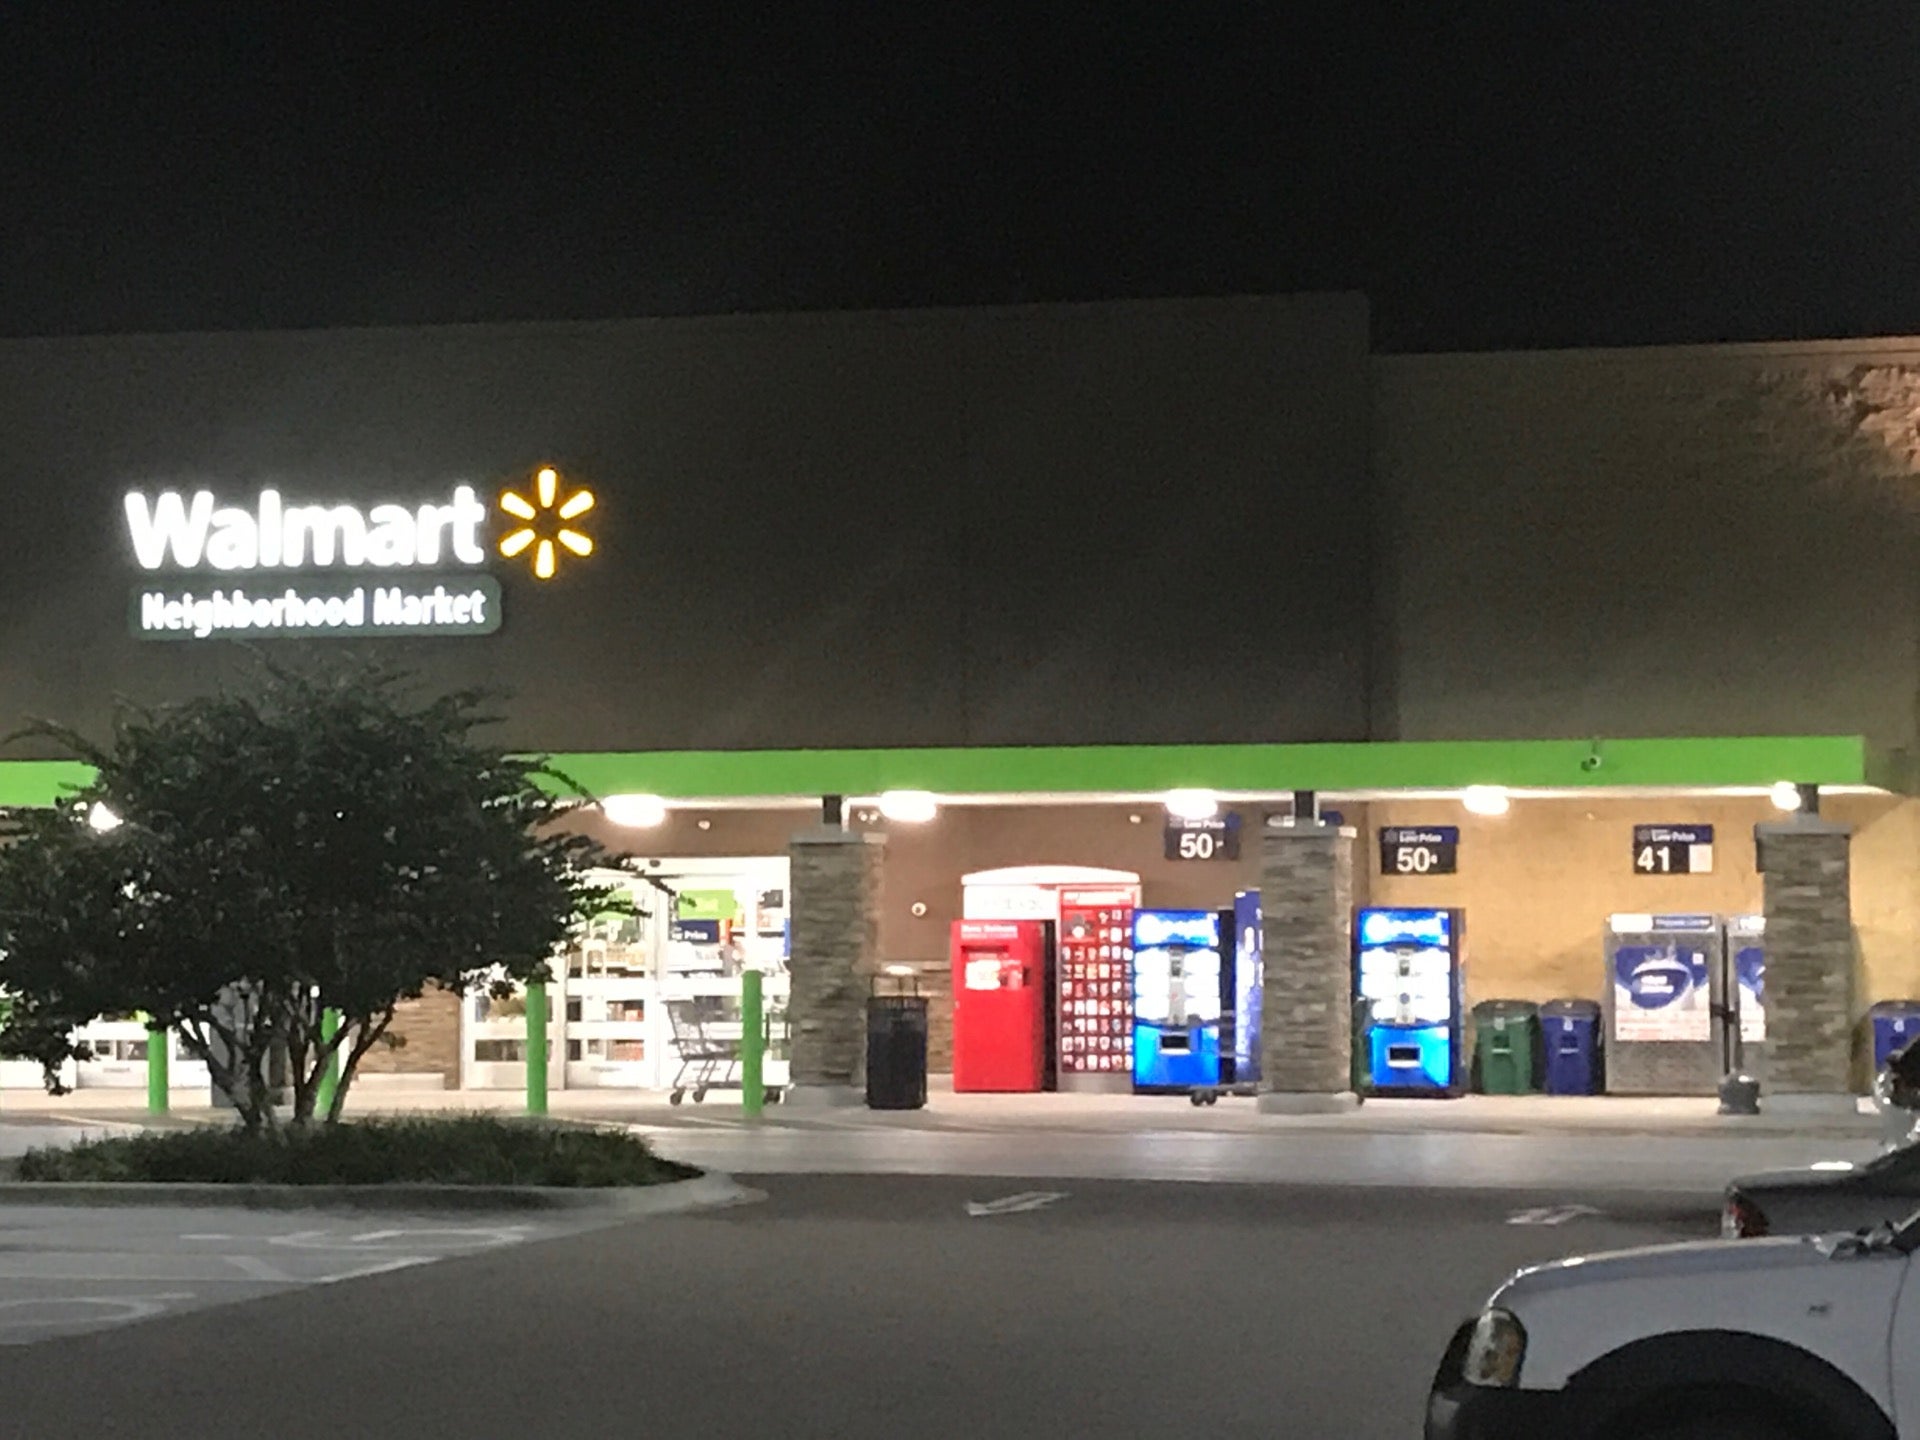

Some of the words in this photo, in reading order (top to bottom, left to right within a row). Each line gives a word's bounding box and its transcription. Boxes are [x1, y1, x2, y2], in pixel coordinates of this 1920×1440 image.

[124, 486, 485, 570] Walmart
[143, 588, 364, 637] Neighborhood
[374, 587, 486, 625] Market
[1637, 845, 1670, 872] 41
